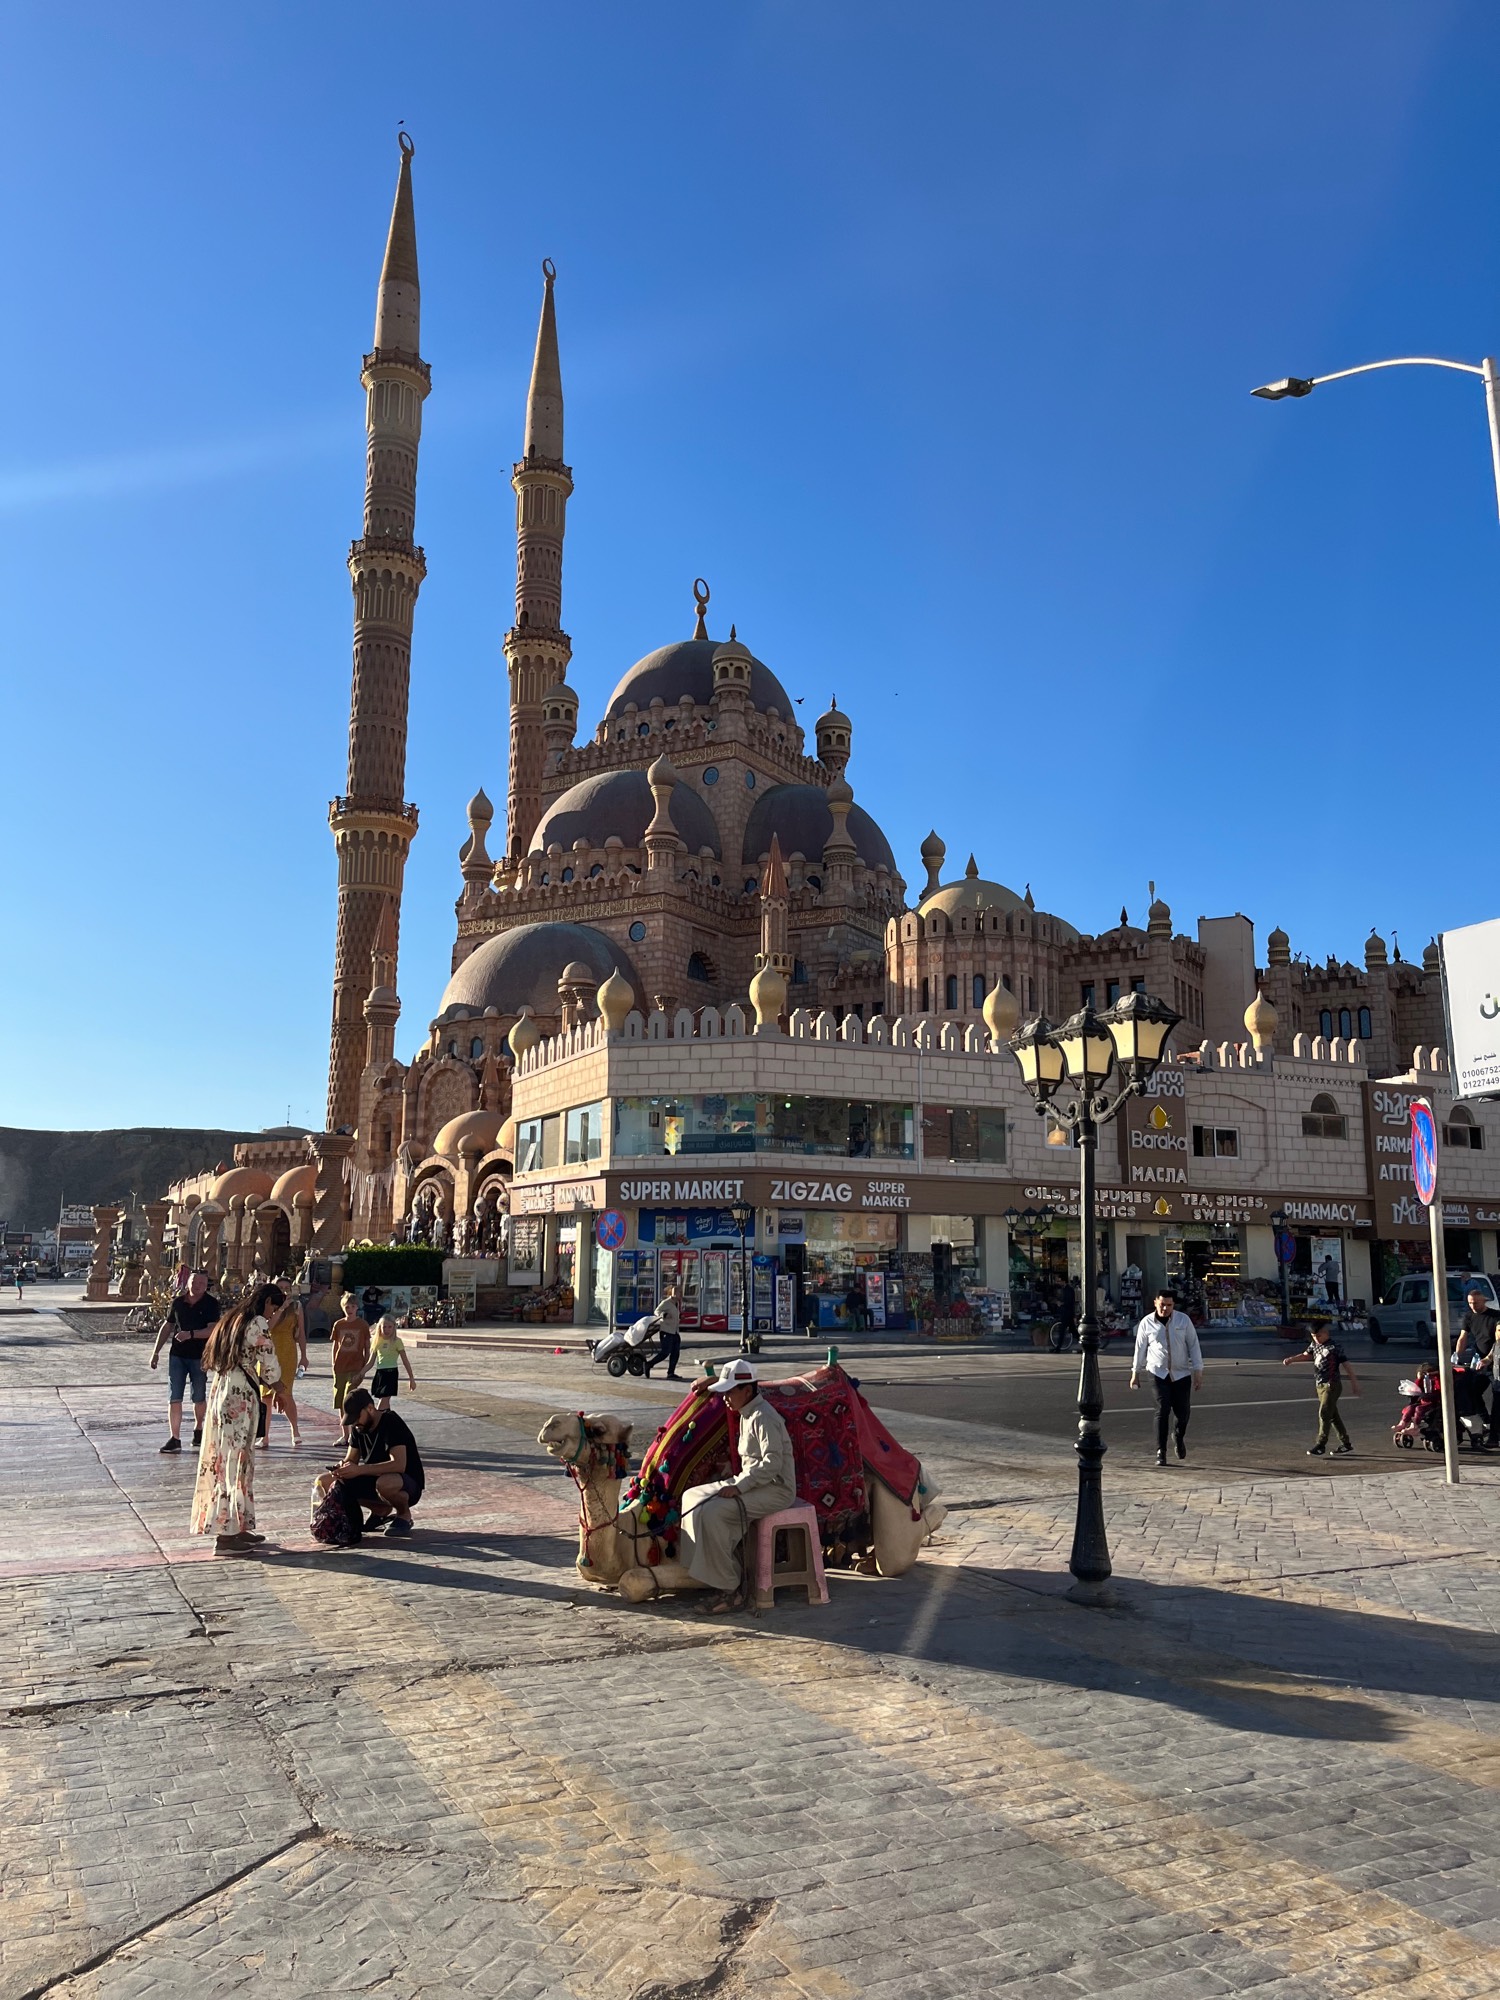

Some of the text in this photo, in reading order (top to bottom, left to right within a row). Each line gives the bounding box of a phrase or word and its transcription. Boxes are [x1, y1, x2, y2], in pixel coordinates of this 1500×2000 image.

[1131, 1130, 1188, 1151] Baraka
[1376, 1135, 1412, 1153] FARMA
[1132, 1166, 1188, 1184] МАСЛА
[1379, 1164, 1415, 1182] АПТЕ
[620, 1180, 744, 1200] SUPER MARKET
[771, 1181, 853, 1202] ZIGZAG
[868, 1182, 905, 1194] SUPER
[1024, 1186, 1151, 1203] OILS, PRFUMES
[862, 1195, 911, 1208] MARKET
[1048, 1204, 1136, 1217] OSETICS
[1181, 1193, 1268, 1210] TEA, SPICES,
[1194, 1209, 1251, 1222] SWEETS
[1284, 1202, 1356, 1221] PHARMACY
